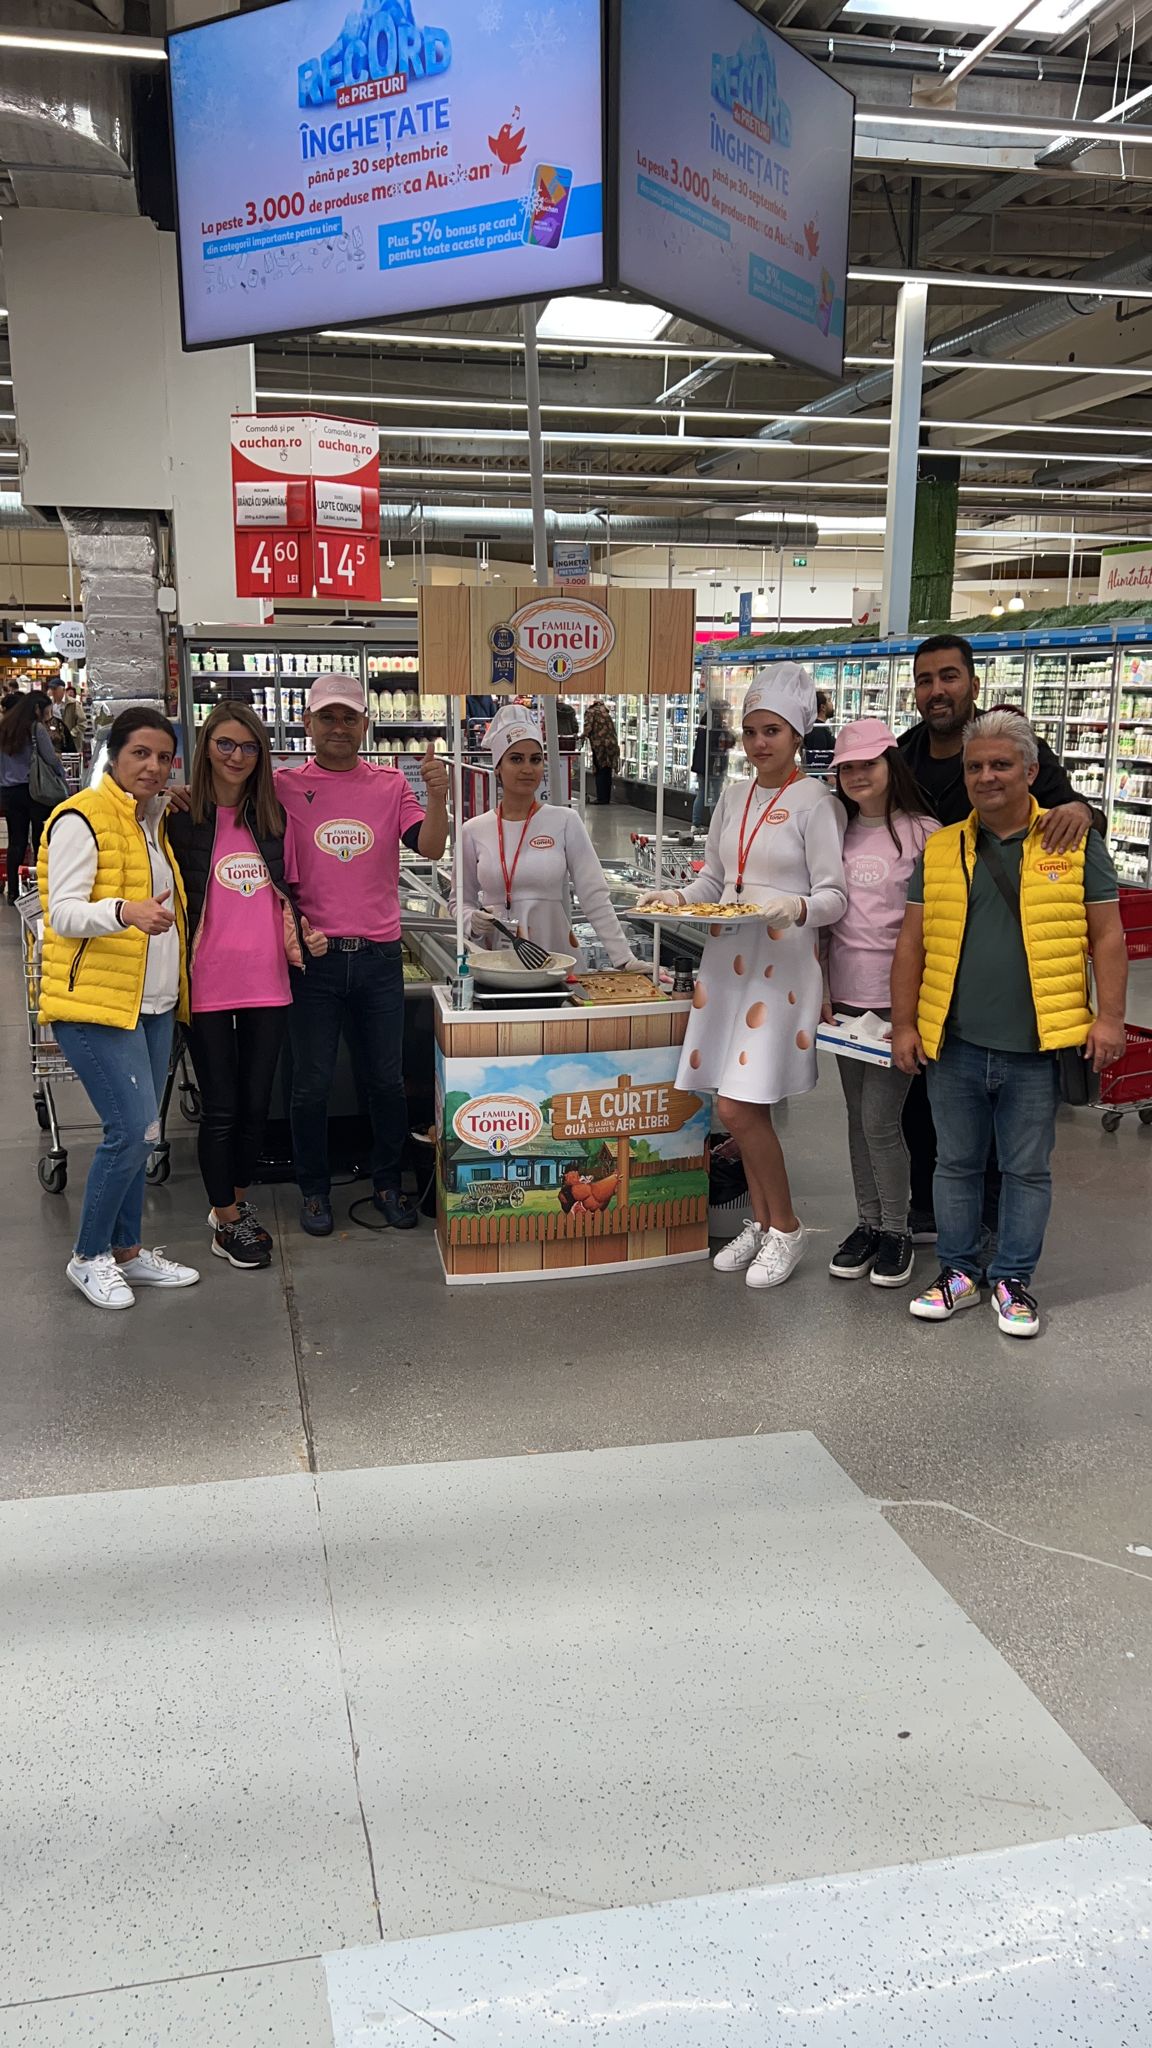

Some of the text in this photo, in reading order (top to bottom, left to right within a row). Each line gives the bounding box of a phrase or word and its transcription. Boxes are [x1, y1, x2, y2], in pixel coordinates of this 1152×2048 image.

[298, 10, 452, 108] RECORD
[338, 92, 350, 105] de
[300, 97, 450, 159] ÎNGHEȚATE
[308, 141, 448, 188] până pe 30 septembrie
[637, 149, 647, 167] La
[648, 160, 669, 181] peste
[670, 158, 710, 202] 3.000
[720, 201, 747, 225] produse
[738, 178, 748, 197] 30
[202, 222, 214, 235] La
[216, 216, 243, 235] peste
[246, 191, 305, 226] 3.000
[309, 199, 322, 213] de
[324, 191, 369, 211] produse
[206, 244, 219, 255] din
[220, 237, 251, 253] categorii
[252, 230, 294, 247] importante
[296, 225, 321, 241] pentru
[388, 235, 409, 249] Plus
[412, 219, 442, 245] 5%
[446, 224, 477, 238] bonus
[479, 219, 492, 235] pe
[493, 214, 517, 229] card
[388, 247, 421, 265] pentru
[423, 243, 450, 256] toate
[452, 236, 485, 251] aceste
[286, 425, 295, 434] pe
[239, 436, 302, 449] auchan.ro
[318, 438, 372, 455] auchan.ro
[317, 500, 362, 513] LAPTE CONSUM
[251, 541, 298, 584] 4 60
[318, 542, 365, 586] 14 5
[287, 574, 298, 584] LEI
[542, 621, 582, 630] FAMILIA
[523, 625, 599, 650] Toneli
[494, 660, 514, 669] TASTE
[324, 831, 366, 845] Toneli
[225, 864, 267, 880] Toneli
[1037, 861, 1068, 872] Toneli
[566, 1088, 669, 1120] LA CURTE
[467, 1112, 530, 1132] Toneli
[482, 1110, 516, 1118] FAMILIA
[616, 1114, 670, 1132] AER LIBER
[564, 1119, 587, 1136] OUĂ
